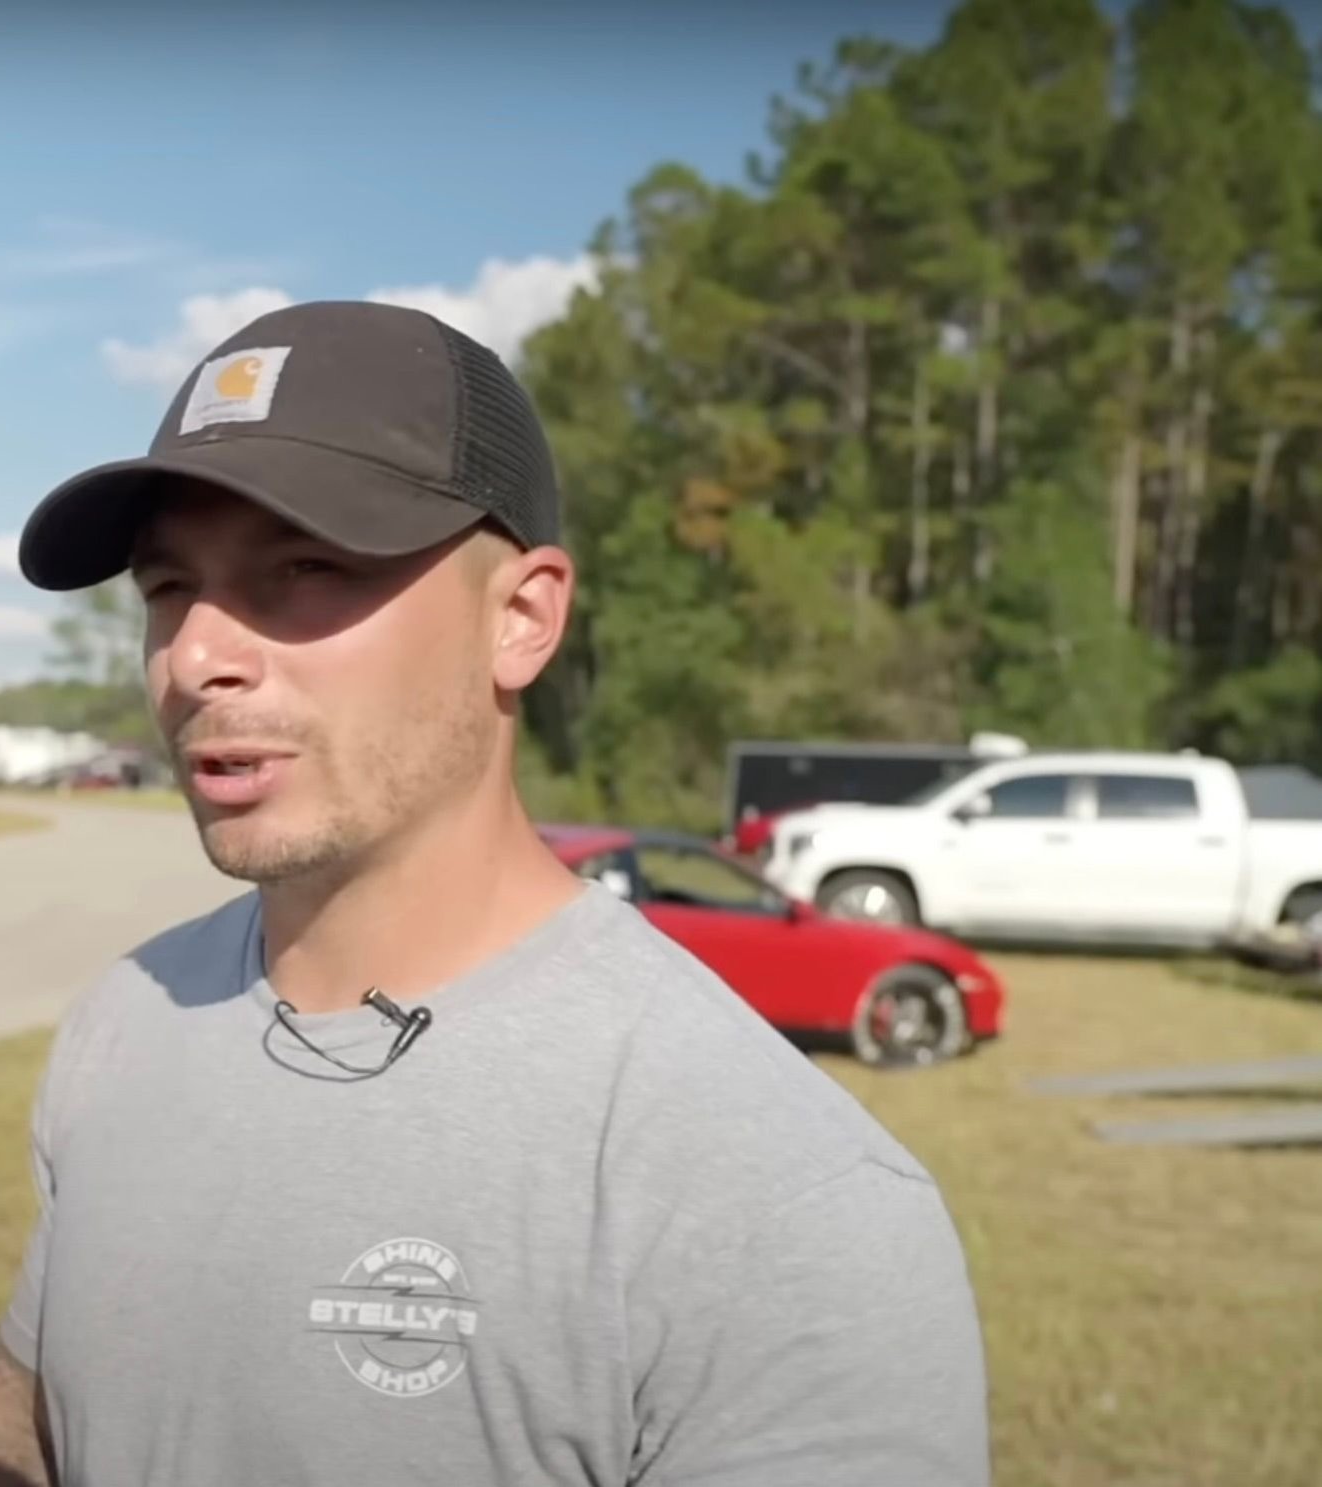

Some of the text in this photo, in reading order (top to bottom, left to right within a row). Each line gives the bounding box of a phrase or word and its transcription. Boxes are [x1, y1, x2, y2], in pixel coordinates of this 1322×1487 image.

[363, 1243, 457, 1281] SHINE
[309, 1299, 477, 1335] STELLY'S
[359, 1359, 448, 1392] SHOP
